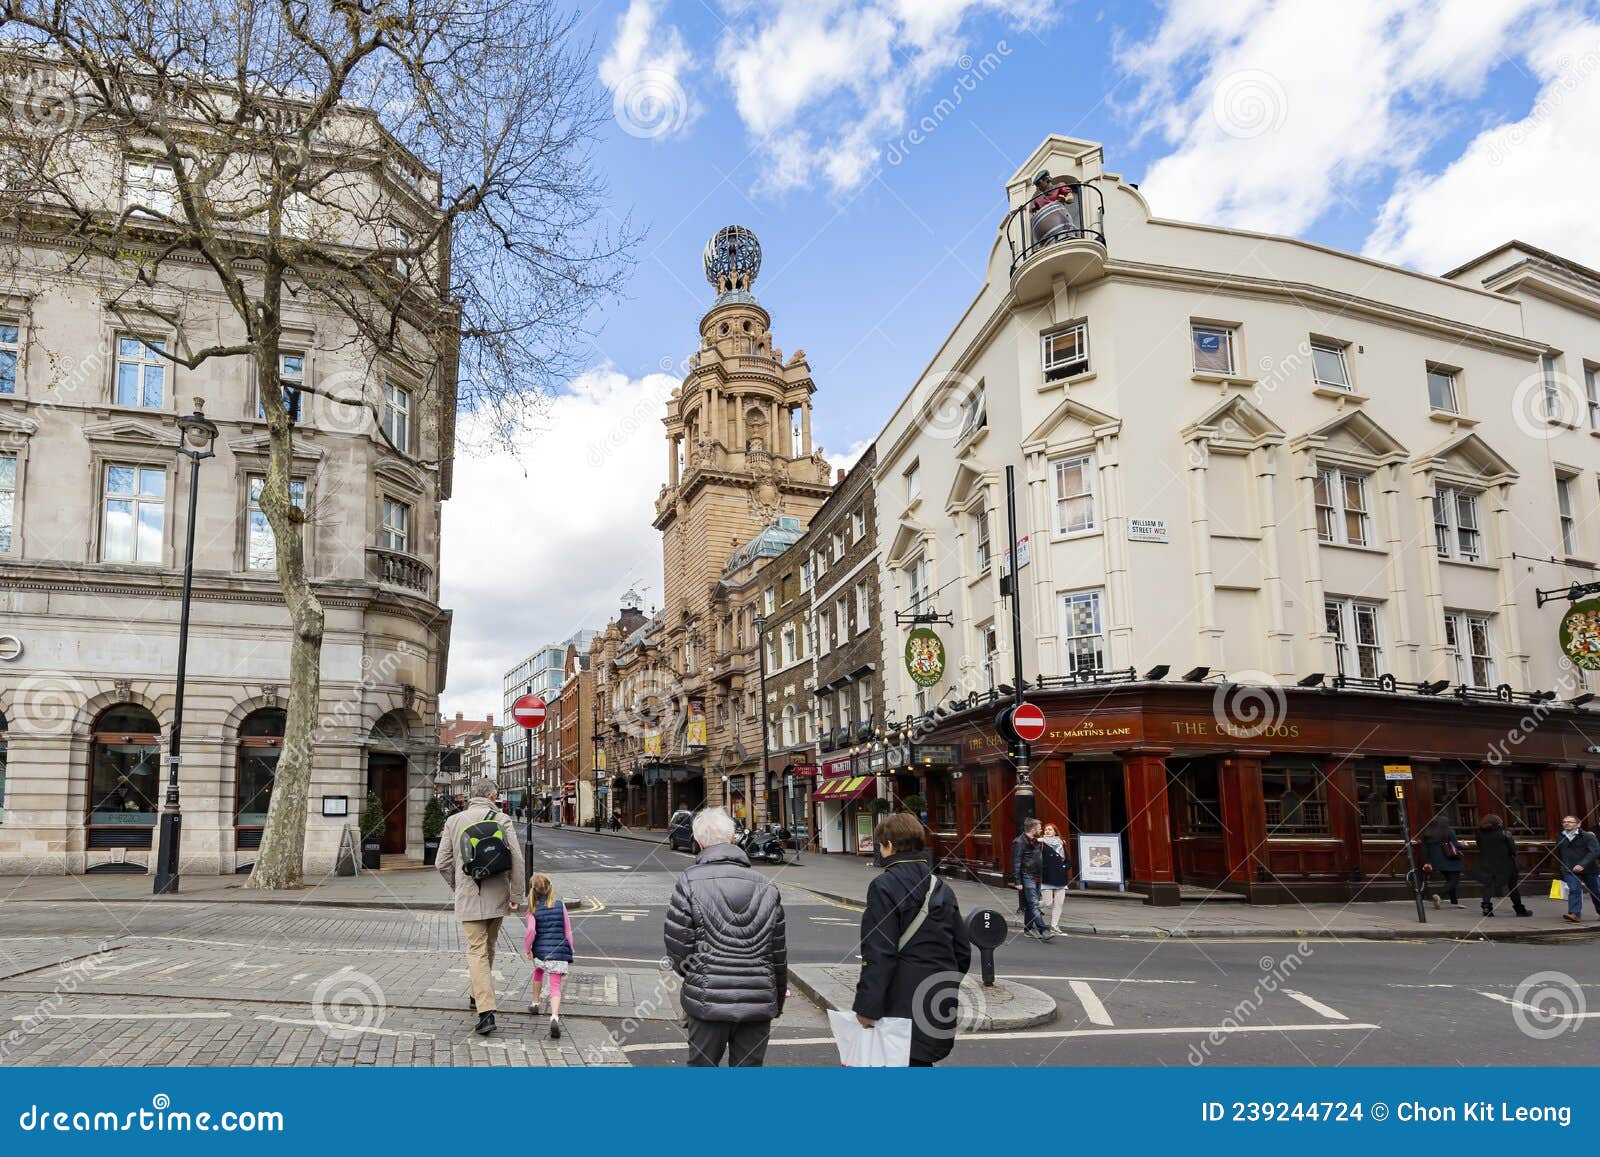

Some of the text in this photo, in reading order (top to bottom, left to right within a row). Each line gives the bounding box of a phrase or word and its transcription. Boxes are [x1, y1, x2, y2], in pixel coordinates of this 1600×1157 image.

[1132, 519, 1156, 527] WILLIAM
[1132, 526, 1152, 534] STREET
[1106, 727, 1131, 736] LANE
[1171, 721, 1299, 738] THE CHANDOS
[984, 912, 990, 920] B
[984, 921, 990, 929] 2
